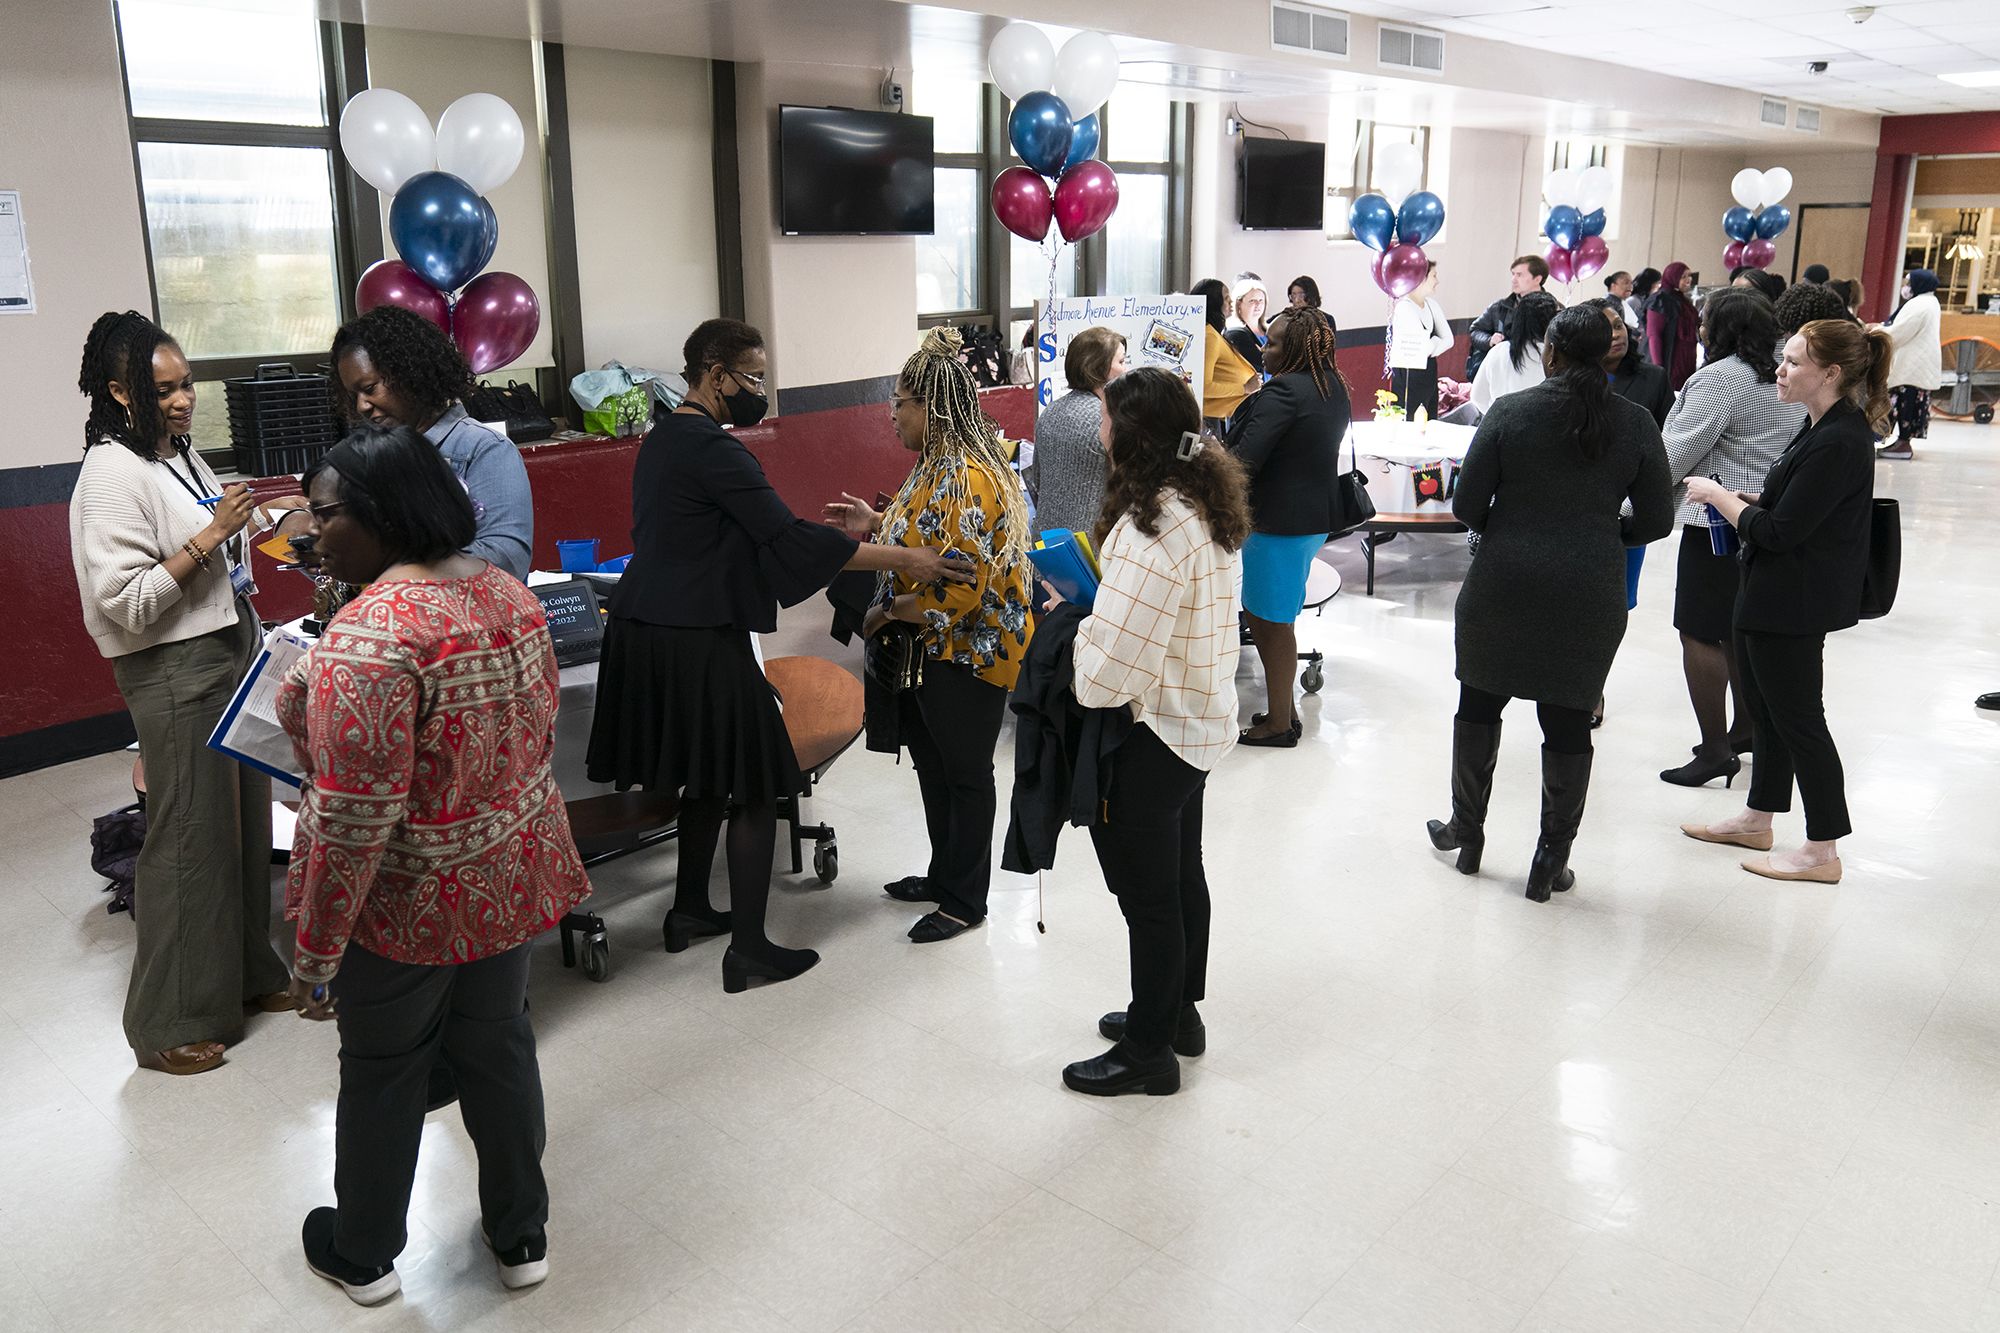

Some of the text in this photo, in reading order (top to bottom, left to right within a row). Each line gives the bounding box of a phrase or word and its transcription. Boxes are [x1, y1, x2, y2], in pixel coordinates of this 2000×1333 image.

[549, 595, 580, 604] Colwyn
[545, 604, 586, 616] earn Year
[546, 616, 576, 627] 1-2022
